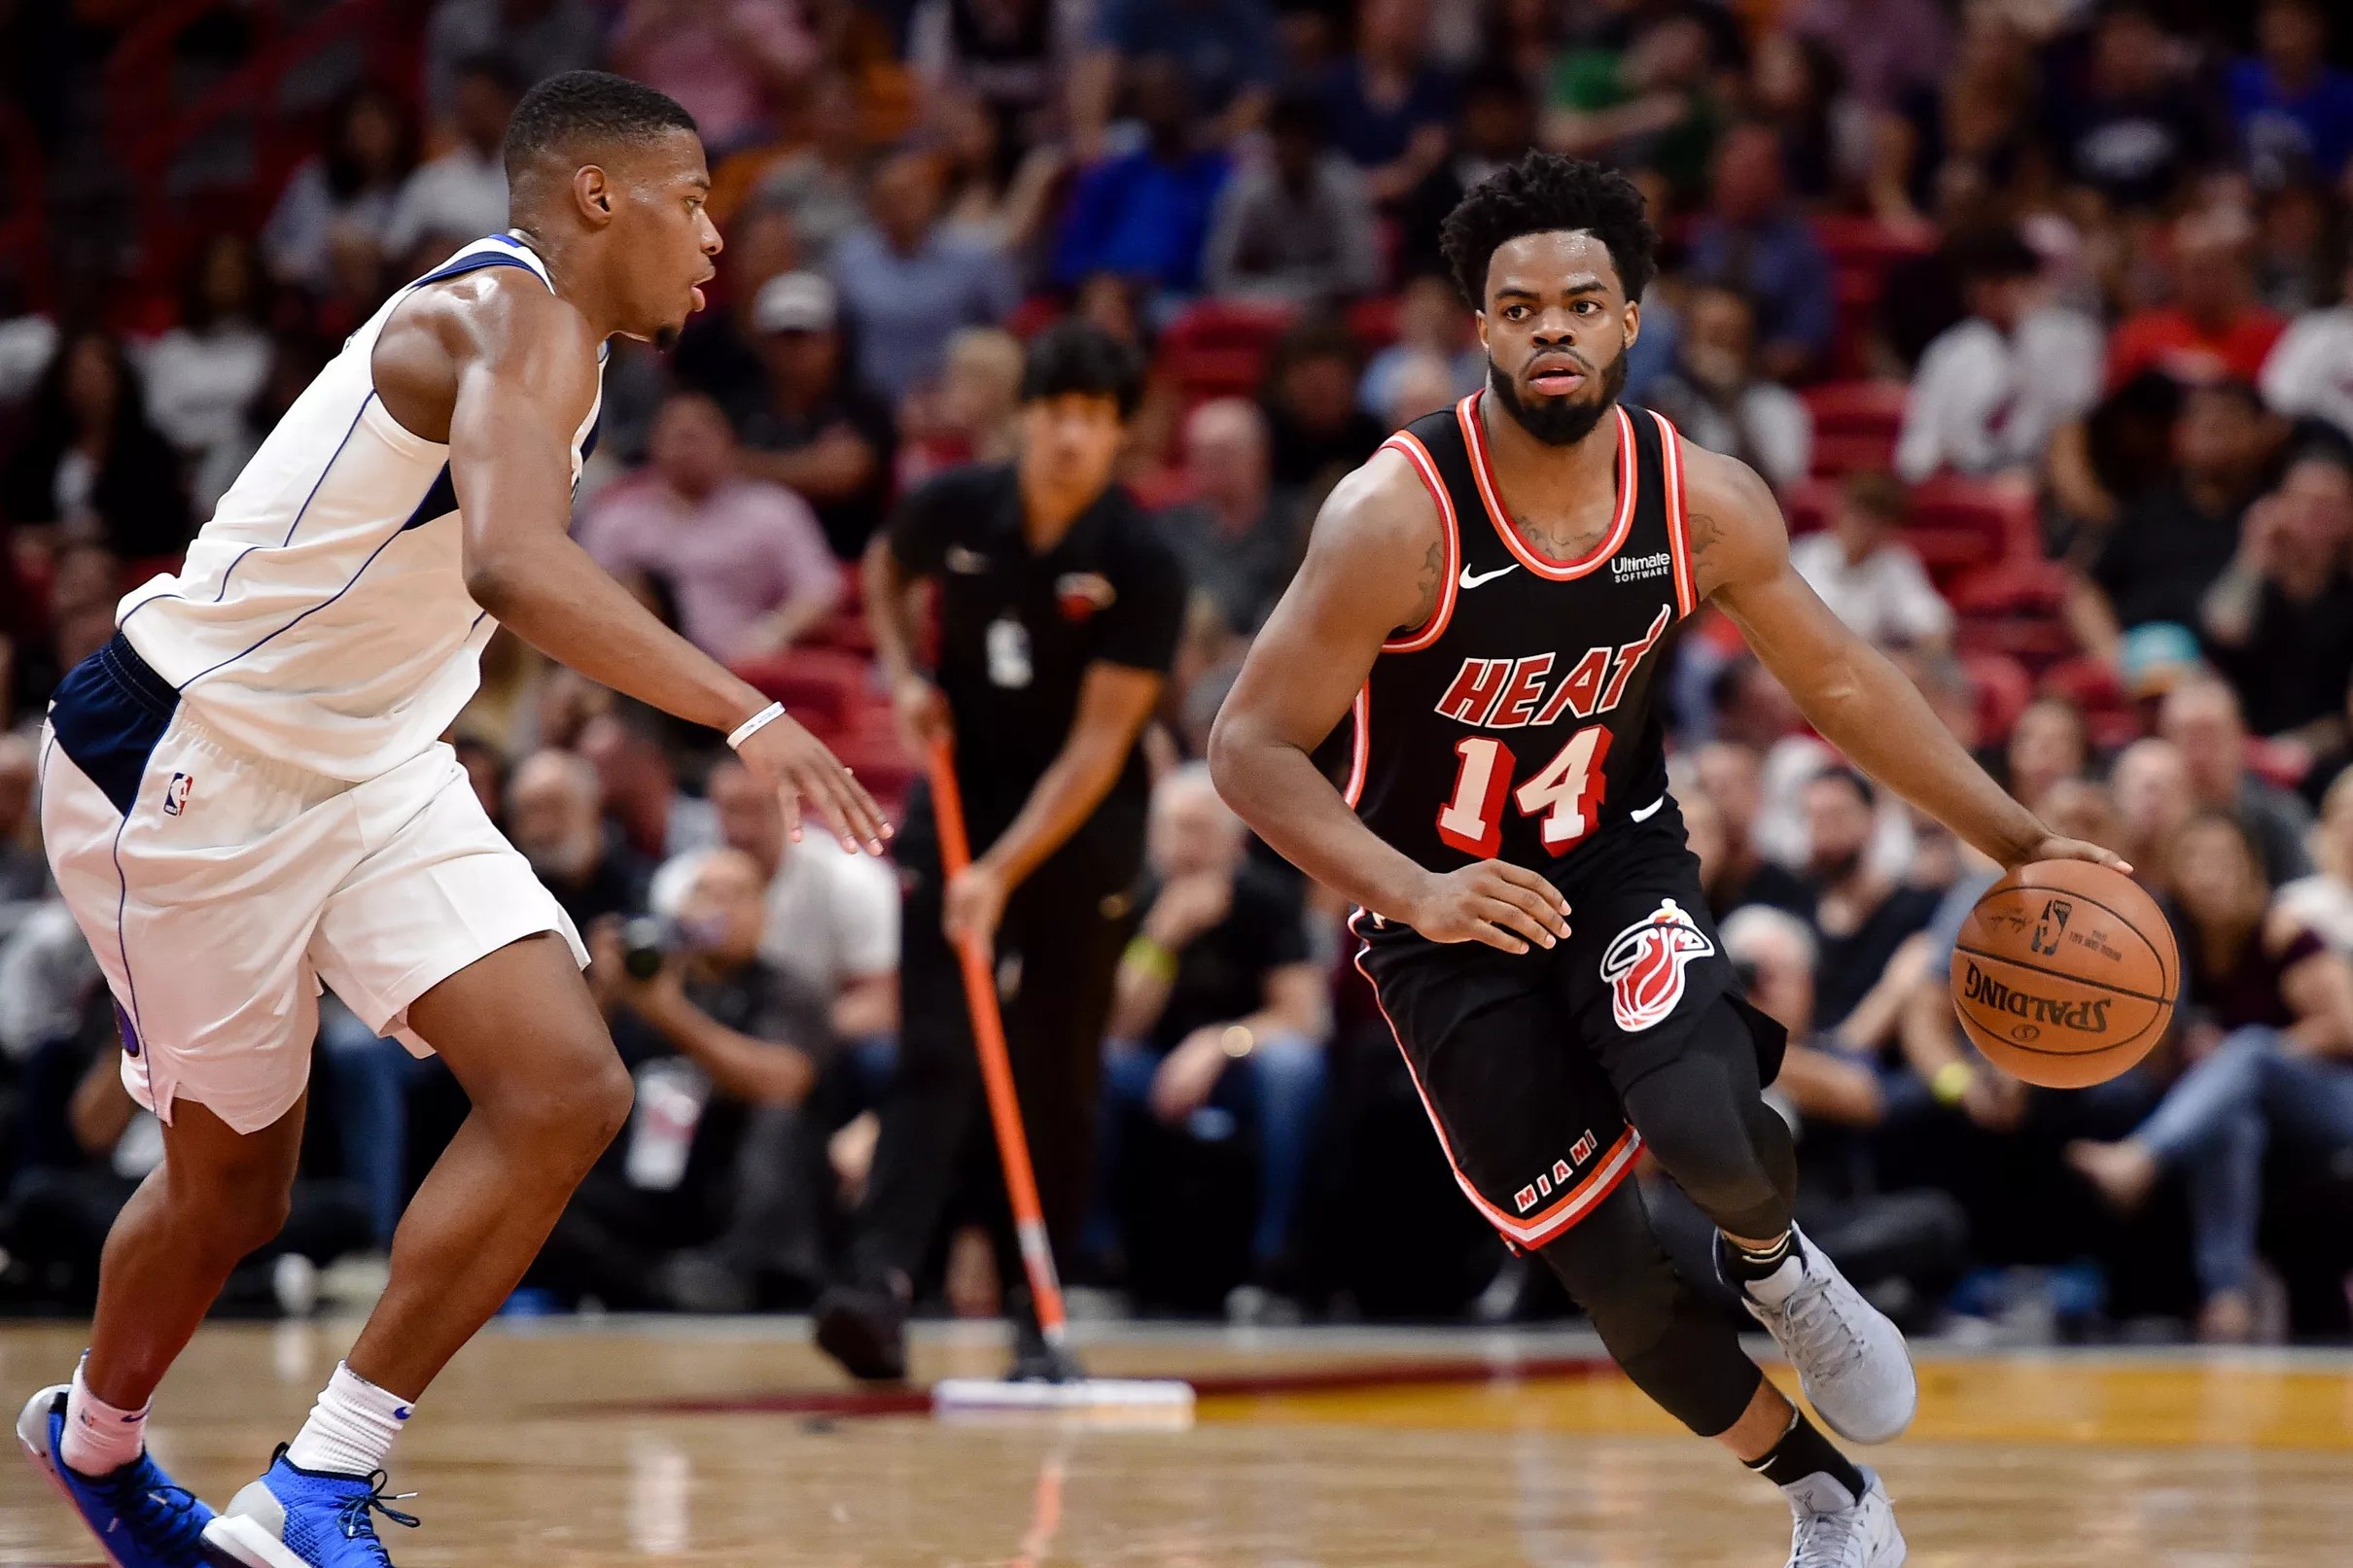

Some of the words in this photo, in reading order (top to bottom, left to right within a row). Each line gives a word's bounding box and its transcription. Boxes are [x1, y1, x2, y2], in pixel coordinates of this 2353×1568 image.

[1611, 552, 1670, 575] Ultimate
[1614, 566, 1669, 583] SOFTWARE
[1434, 603, 1671, 729] HEAT
[1435, 723, 1614, 859] 14
[1964, 958, 2112, 1033] SPALDING
[1514, 1129, 1598, 1213] MIAMI
